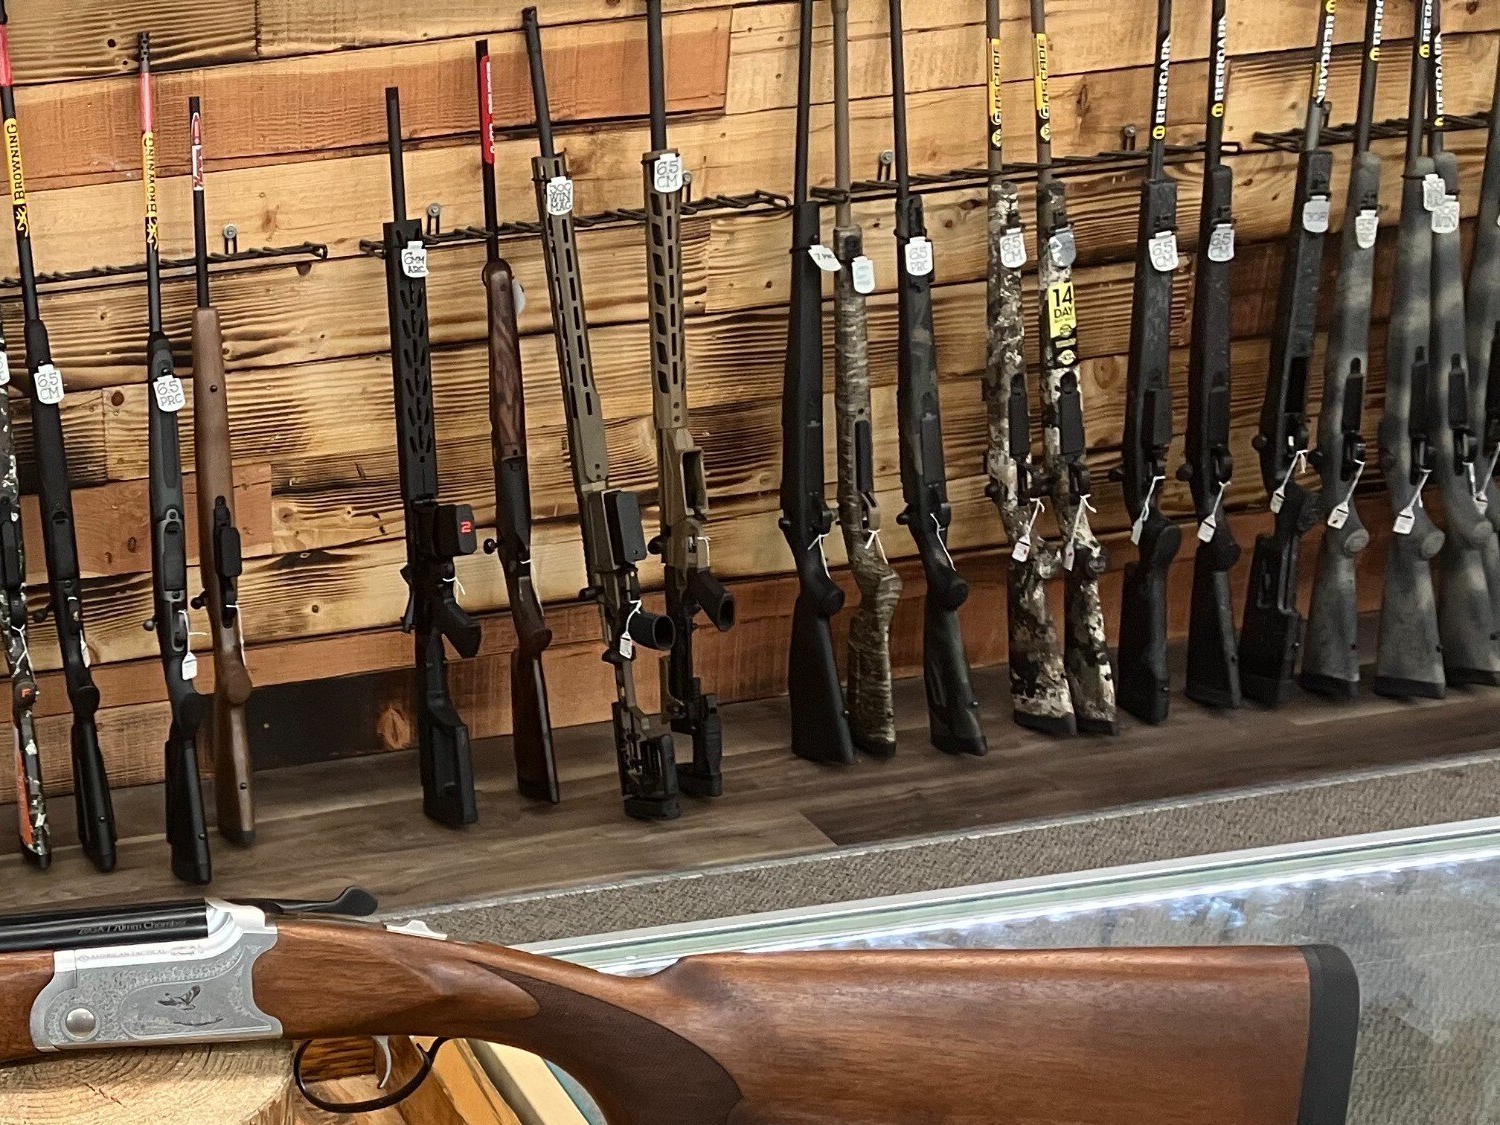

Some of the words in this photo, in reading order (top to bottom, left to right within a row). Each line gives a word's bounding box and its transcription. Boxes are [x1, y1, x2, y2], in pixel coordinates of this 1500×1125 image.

[1155, 33, 1171, 124] BERGARA
[6, 123, 26, 202] BROWNING
[143, 137, 158, 213] BROWNING
[656, 174, 679, 188] CM
[550, 192, 571, 204] WIN
[1052, 285, 1073, 308] 14
[1053, 305, 1074, 319] DAY
[39, 386, 61, 401] CM
[159, 392, 184, 408] PRC
[460, 520, 472, 533] 2
